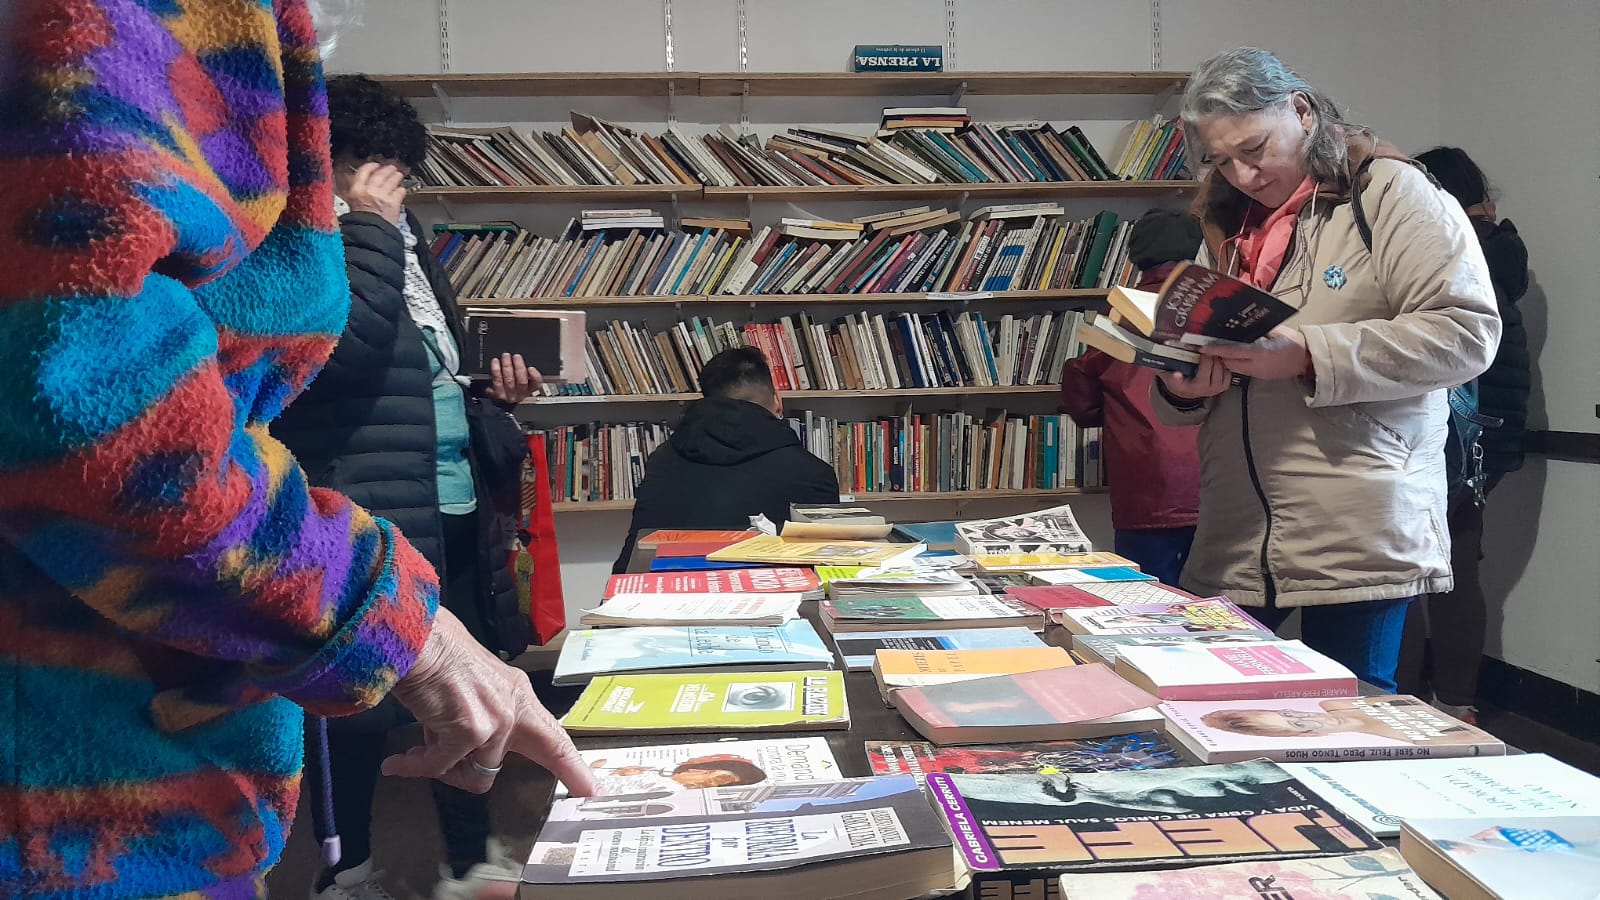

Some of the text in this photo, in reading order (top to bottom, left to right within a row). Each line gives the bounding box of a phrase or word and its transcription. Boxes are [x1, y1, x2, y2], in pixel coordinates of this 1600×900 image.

[859, 56, 918, 66] PRENSA
[922, 57, 941, 66] LA
[1166, 276, 1198, 312] JOHN
[1174, 272, 1219, 328] GRISHAM
[1273, 688, 1348, 698] MARIE FERRARELLA
[1286, 750, 1309, 758] HIJOS
[1312, 750, 1339, 758] TENGO
[1343, 750, 1366, 758] PERO
[1417, 748, 1430, 756] NO
[1275, 804, 1320, 813] VIDA
[1104, 815, 1172, 823] CARLOS
[1204, 810, 1255, 818] OBRA
[934, 776, 988, 864] GABRIELA CERRUTI
[745, 819, 799, 860] REFORMA
[801, 830, 828, 840] La
[984, 812, 1321, 864] JEFE
[657, 825, 711, 866] DENTRO
[712, 837, 741, 848] por
